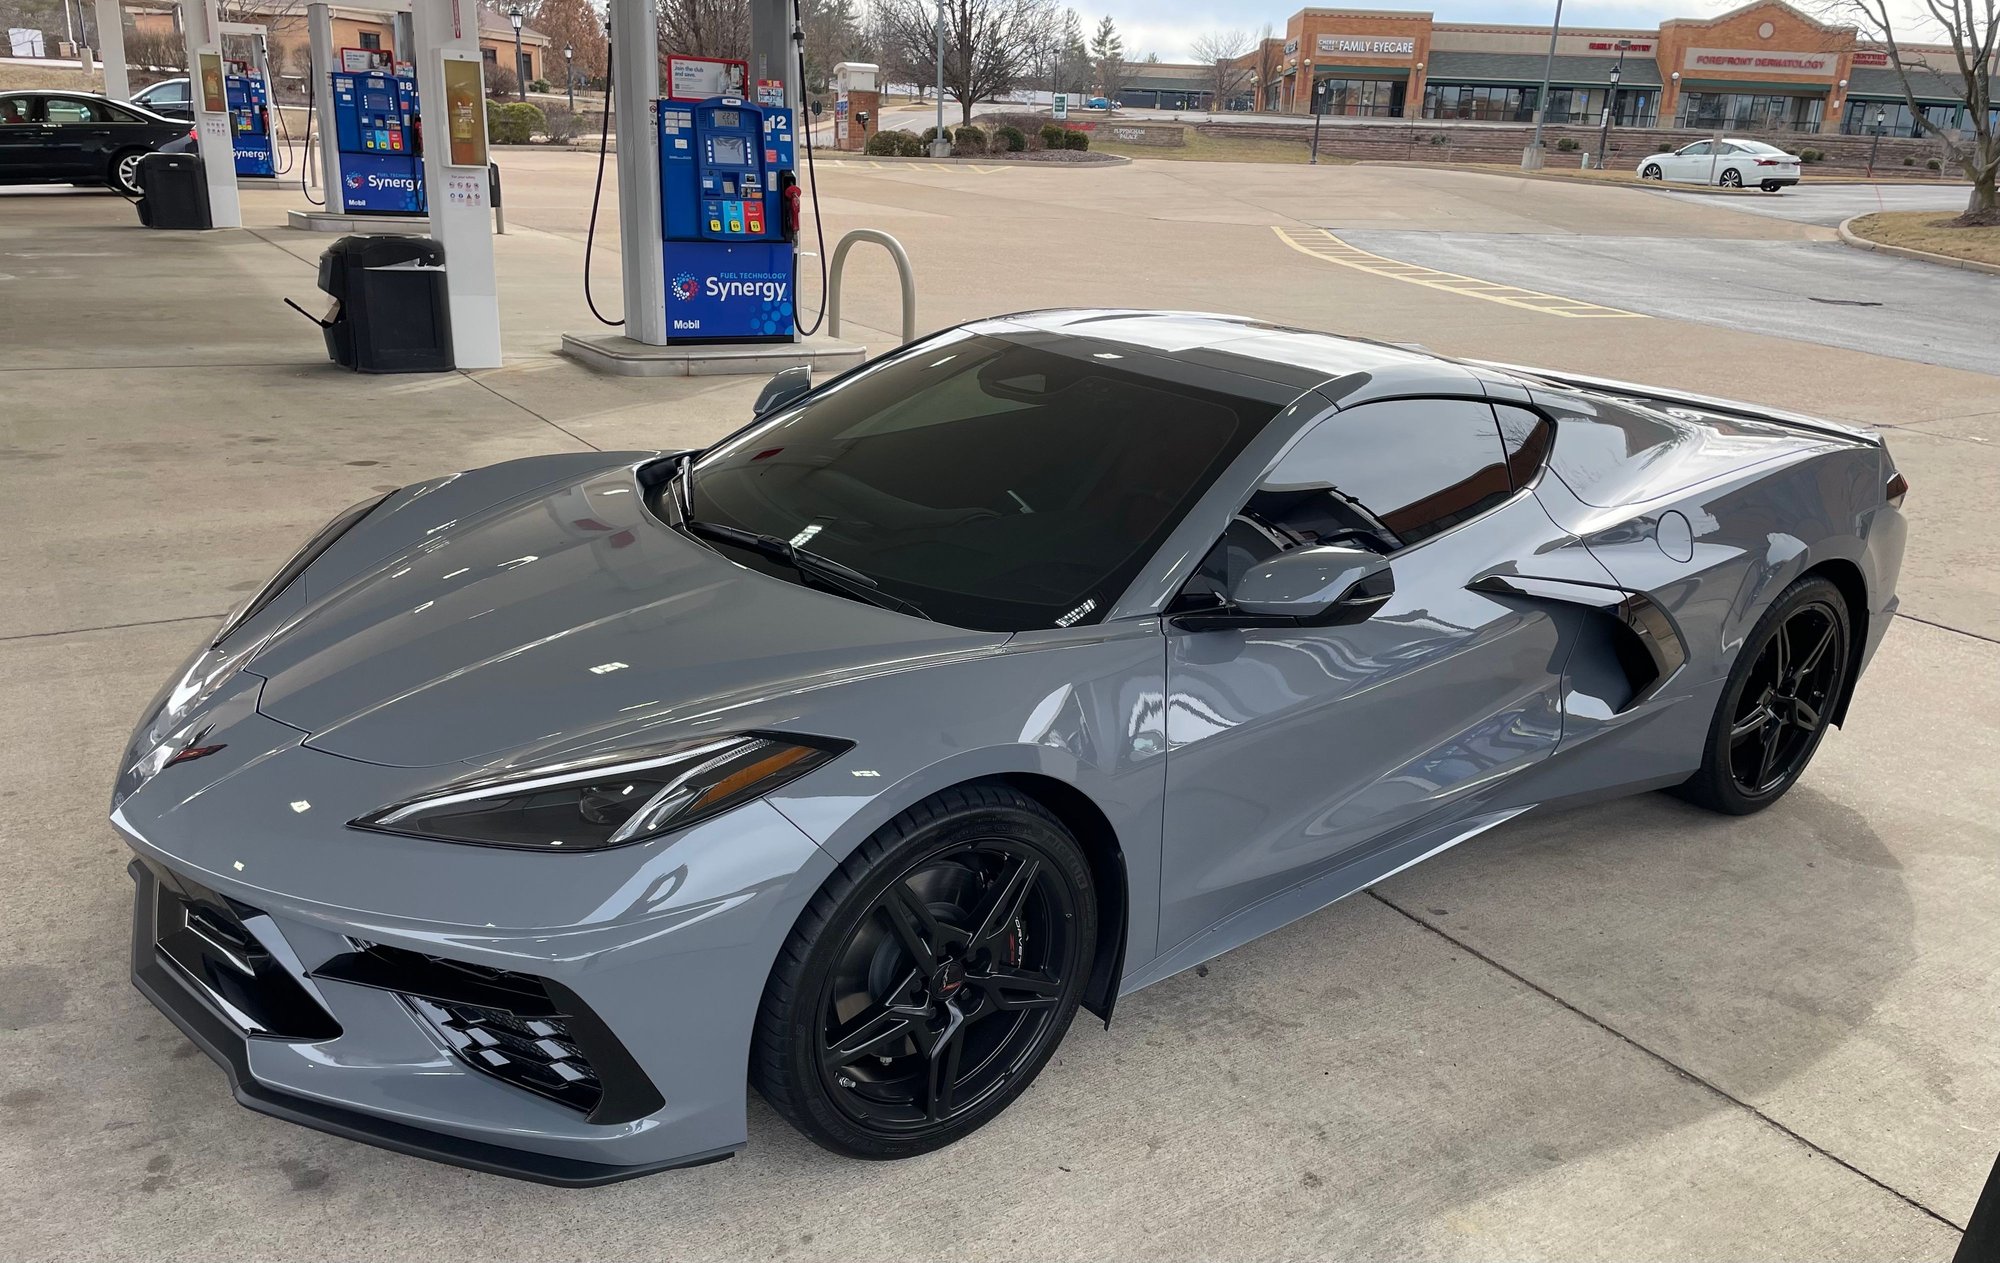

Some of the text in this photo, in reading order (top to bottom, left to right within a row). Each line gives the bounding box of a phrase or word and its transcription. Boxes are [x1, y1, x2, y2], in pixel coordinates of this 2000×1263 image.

[1338, 40, 1414, 53] FAMILY EYECARE
[1696, 55, 1825, 69] FOREFRONT DERMATOLOGY
[768, 114, 787, 130] 12
[739, 272, 787, 280] TECHNOLOGY
[705, 276, 787, 302] Synergy
[673, 320, 700, 330] Mobil
